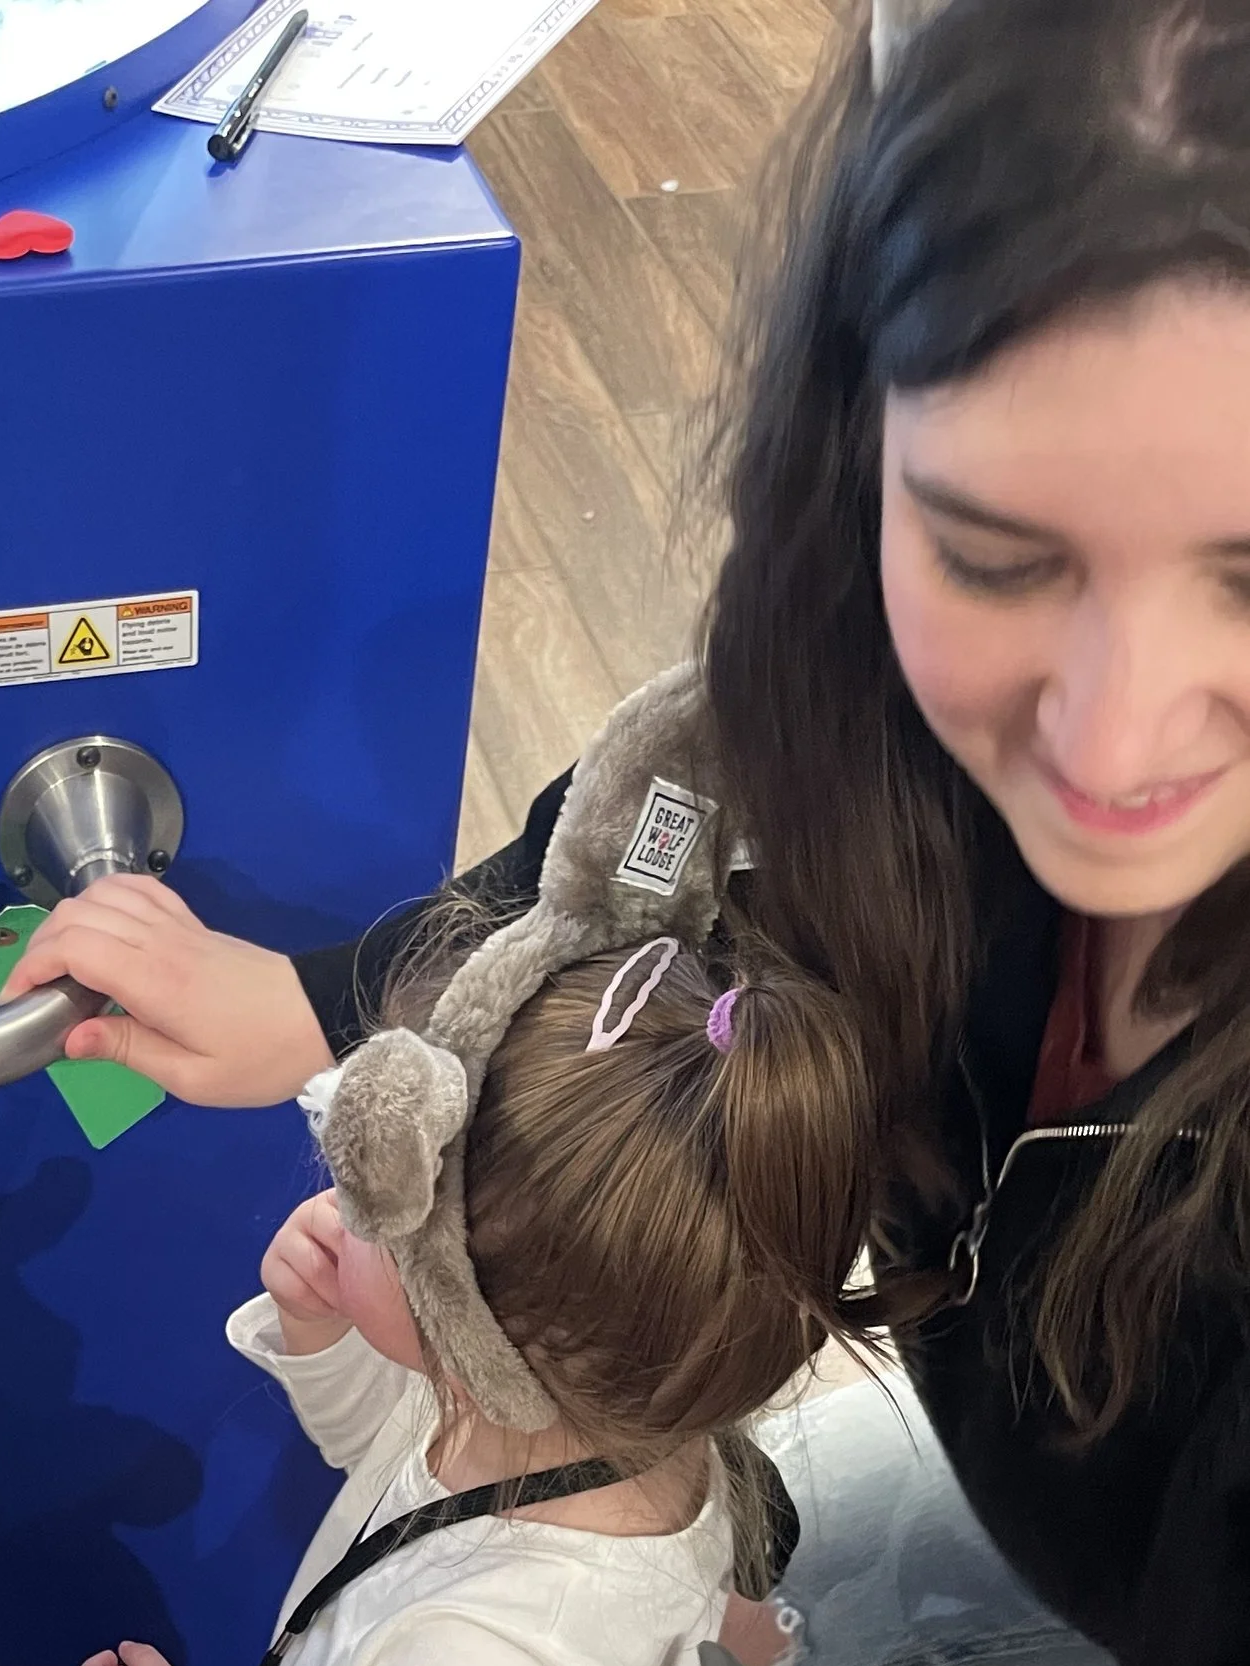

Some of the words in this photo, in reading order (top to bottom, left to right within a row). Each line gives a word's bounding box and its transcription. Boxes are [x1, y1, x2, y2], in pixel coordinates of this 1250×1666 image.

[134, 602, 188, 615] WARNING
[655, 807, 695, 835] GREAT
[637, 844, 675, 871] LODGE
